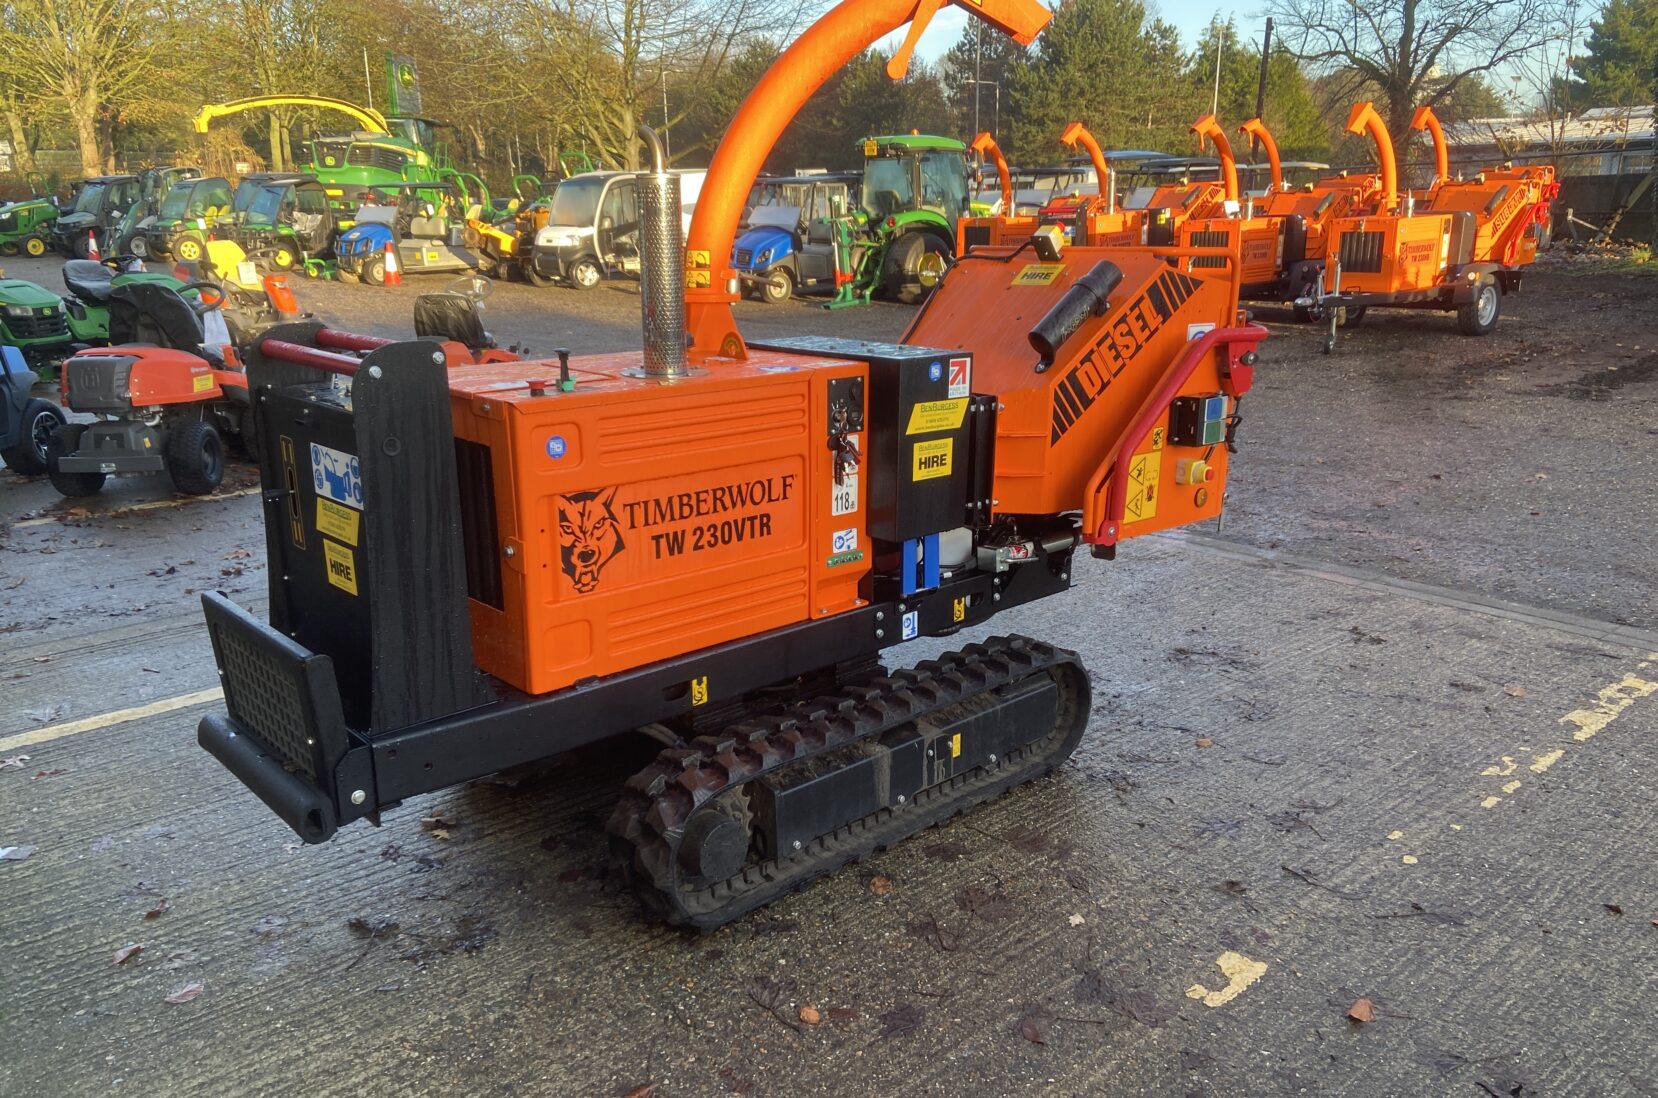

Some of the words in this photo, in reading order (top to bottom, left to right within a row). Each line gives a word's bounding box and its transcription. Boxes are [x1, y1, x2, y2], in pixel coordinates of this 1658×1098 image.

[1020, 272, 1054, 280] HIRE
[1075, 297, 1164, 400] DIESEL
[918, 453, 947, 471] HIRE
[623, 474, 795, 530] TIMBERWOLF
[835, 492, 849, 513] 118
[651, 529, 686, 560] TW
[692, 512, 772, 552] 230VTR
[329, 557, 352, 583] HIRE
